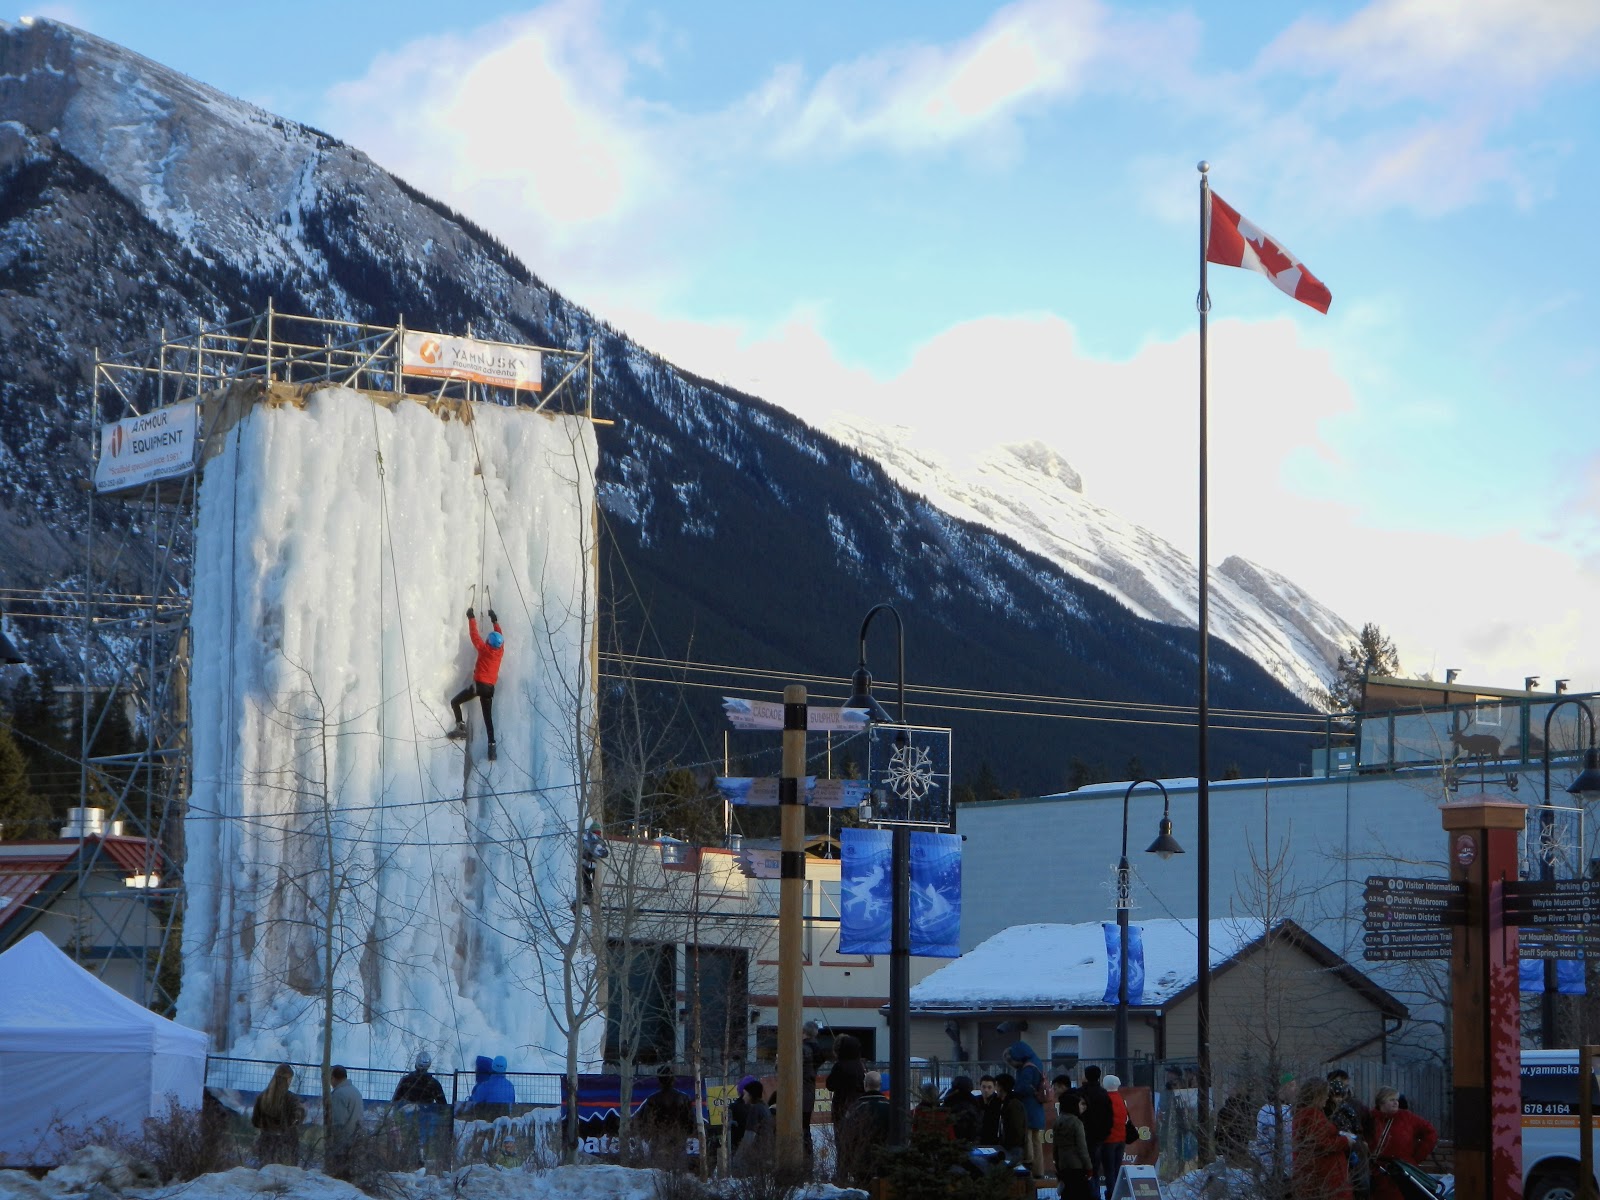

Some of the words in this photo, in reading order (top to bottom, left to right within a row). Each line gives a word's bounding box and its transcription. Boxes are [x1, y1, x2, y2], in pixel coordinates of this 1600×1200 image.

[452, 359, 482, 373] mountain
[132, 412, 168, 433] ARMOUR
[133, 430, 183, 453] EQUIPMENT
[753, 707, 782, 720] CASCADE
[810, 713, 840, 723] SULPHUR
[1405, 881, 1424, 889] Visitor
[1426, 882, 1460, 891] Information
[1556, 883, 1580, 891] Parking
[1394, 896, 1412, 904] Public
[1414, 897, 1448, 906] Washrooms
[1532, 900, 1552, 908] Whyte
[1394, 912, 1416, 921] Uptown
[1418, 913, 1441, 921] District
[1534, 914, 1547, 922] Bow
[1392, 934, 1410, 942] Tunnel
[1536, 949, 1558, 957] Springs
[1524, 1104, 1542, 1114] 678
[1545, 1104, 1570, 1114] 4164
